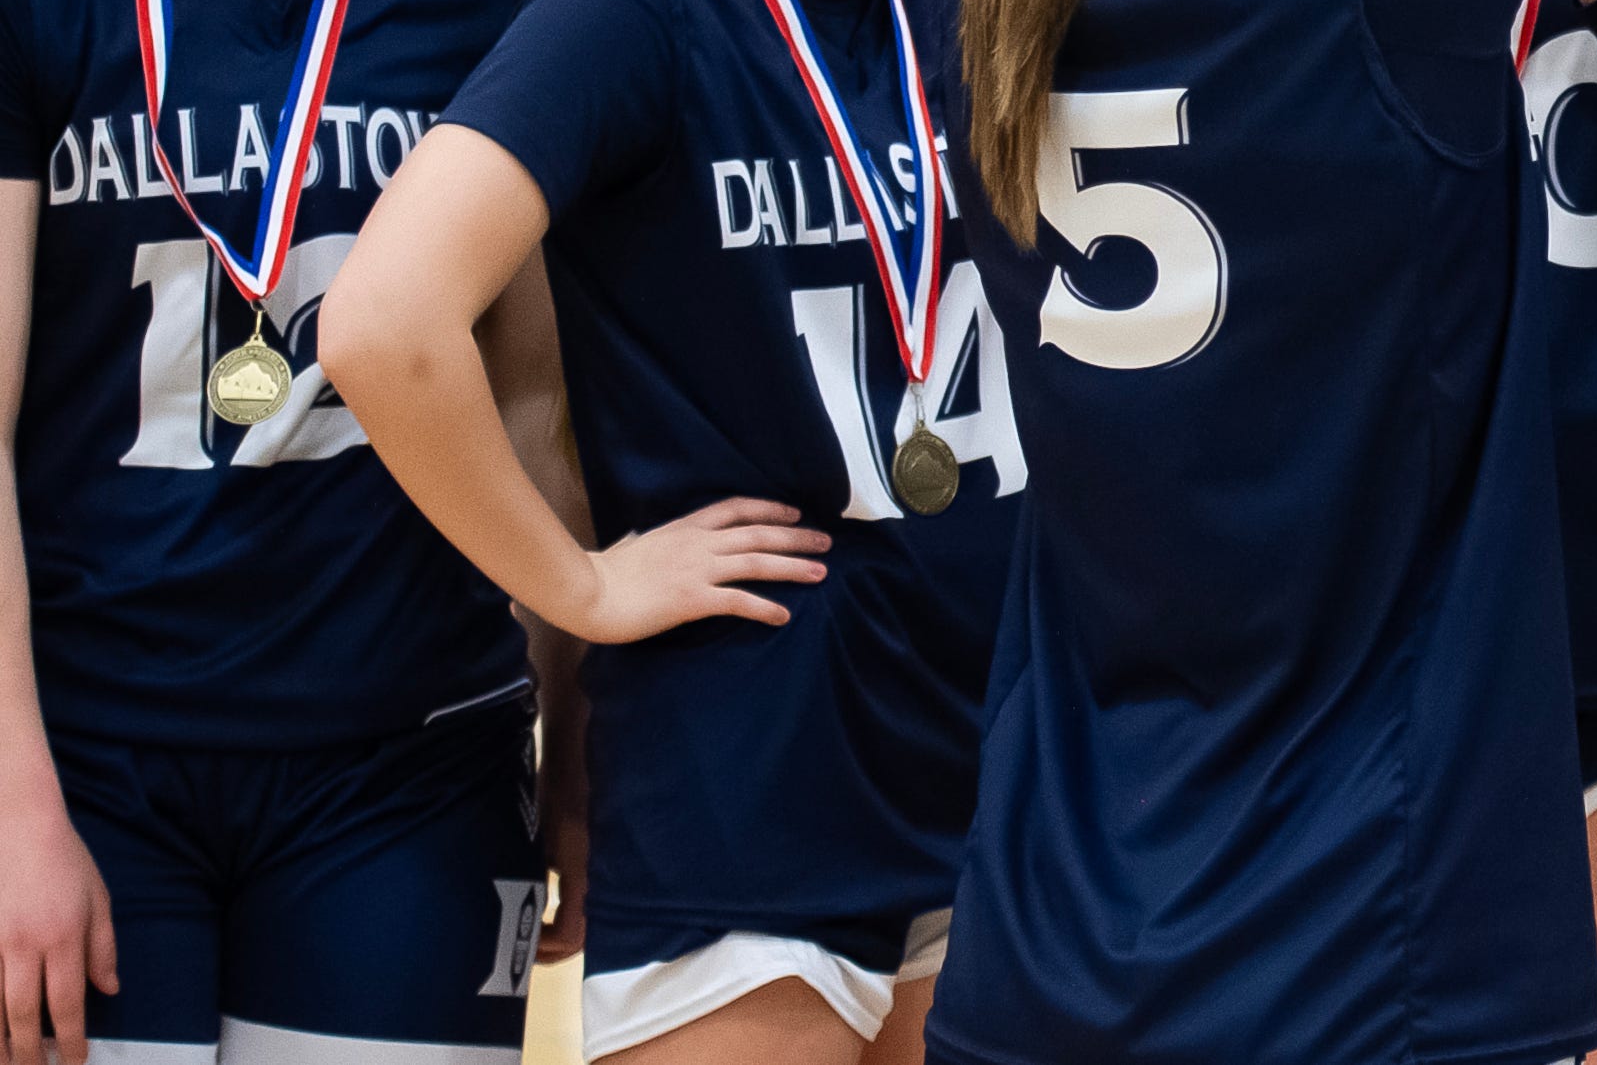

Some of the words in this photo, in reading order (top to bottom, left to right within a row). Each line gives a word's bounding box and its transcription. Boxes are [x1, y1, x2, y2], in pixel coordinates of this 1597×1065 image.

[49, 101, 440, 206] DALLATO
[1036, 87, 1229, 371] 5
[118, 232, 372, 470] 12
[791, 259, 1029, 521] 14
